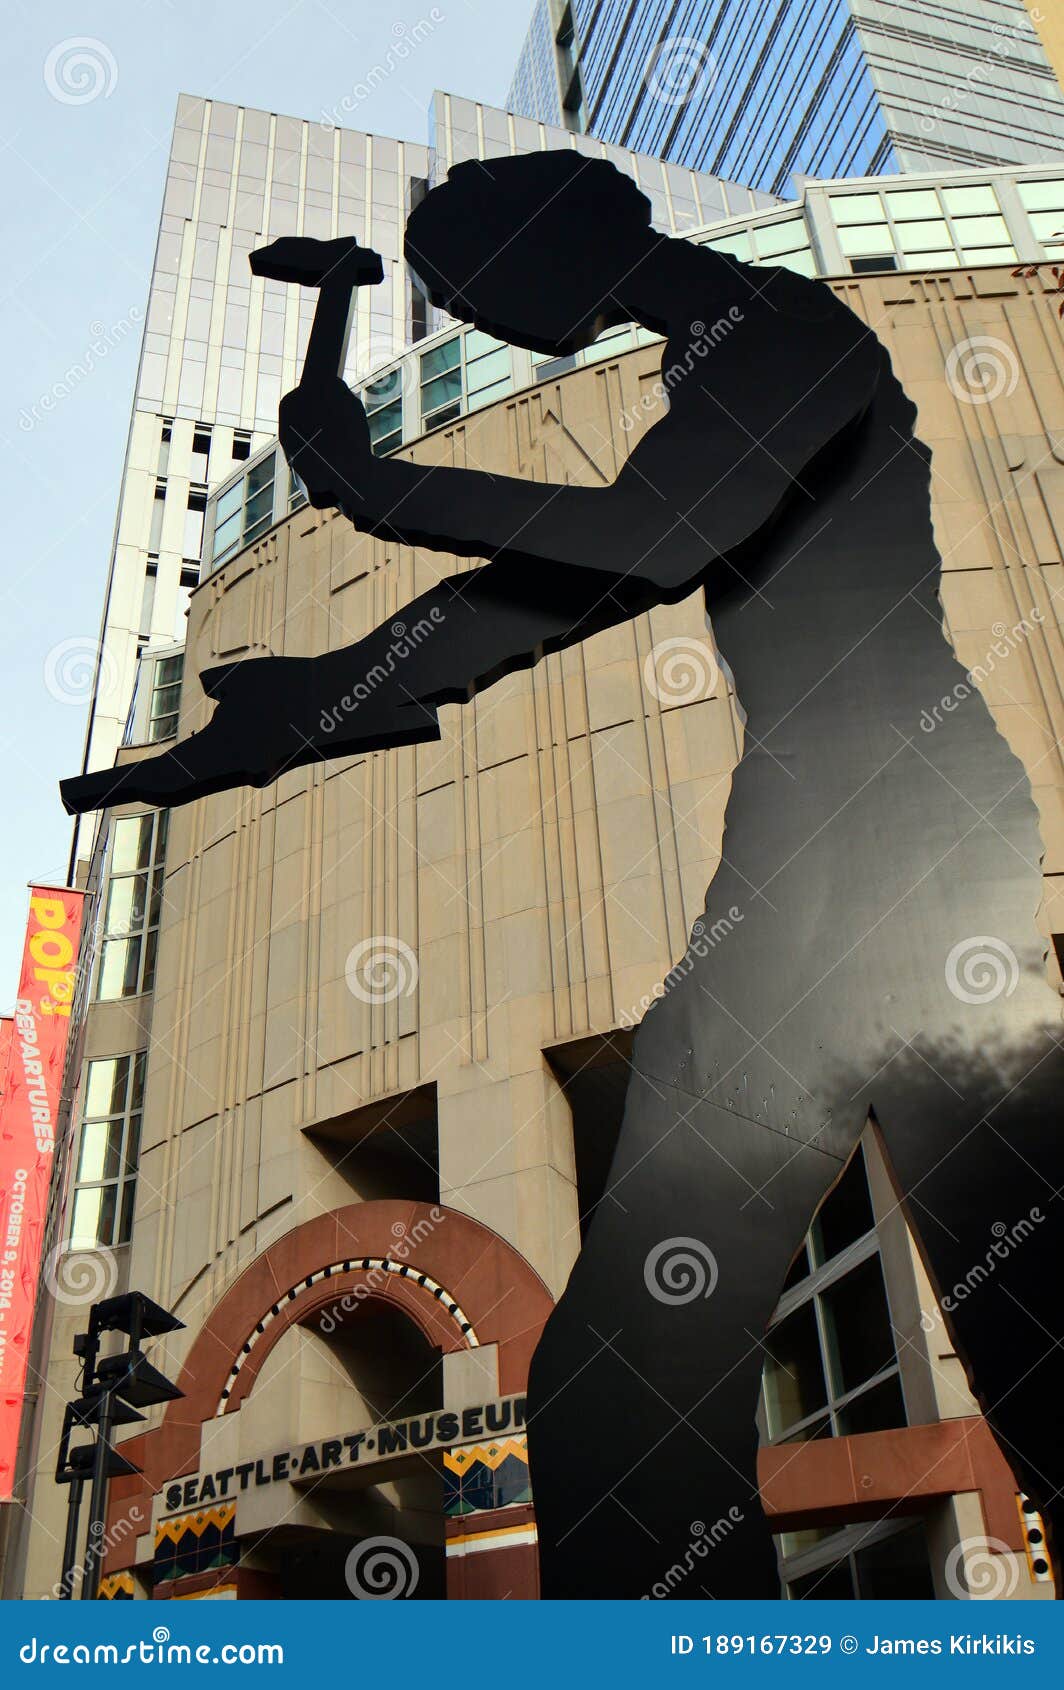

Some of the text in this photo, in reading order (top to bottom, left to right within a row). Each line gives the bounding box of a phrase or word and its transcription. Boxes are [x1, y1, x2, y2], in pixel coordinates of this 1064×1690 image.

[29, 896, 75, 1017] POP!
[16, 999, 55, 1154] DEPARTURES
[6, 1168, 28, 1246] OCTOBER
[0, 1269, 16, 1309] 2014
[2, 1250, 17, 1265] 9,
[165, 1452, 291, 1510] SEATTLE
[299, 1432, 369, 1473] ART
